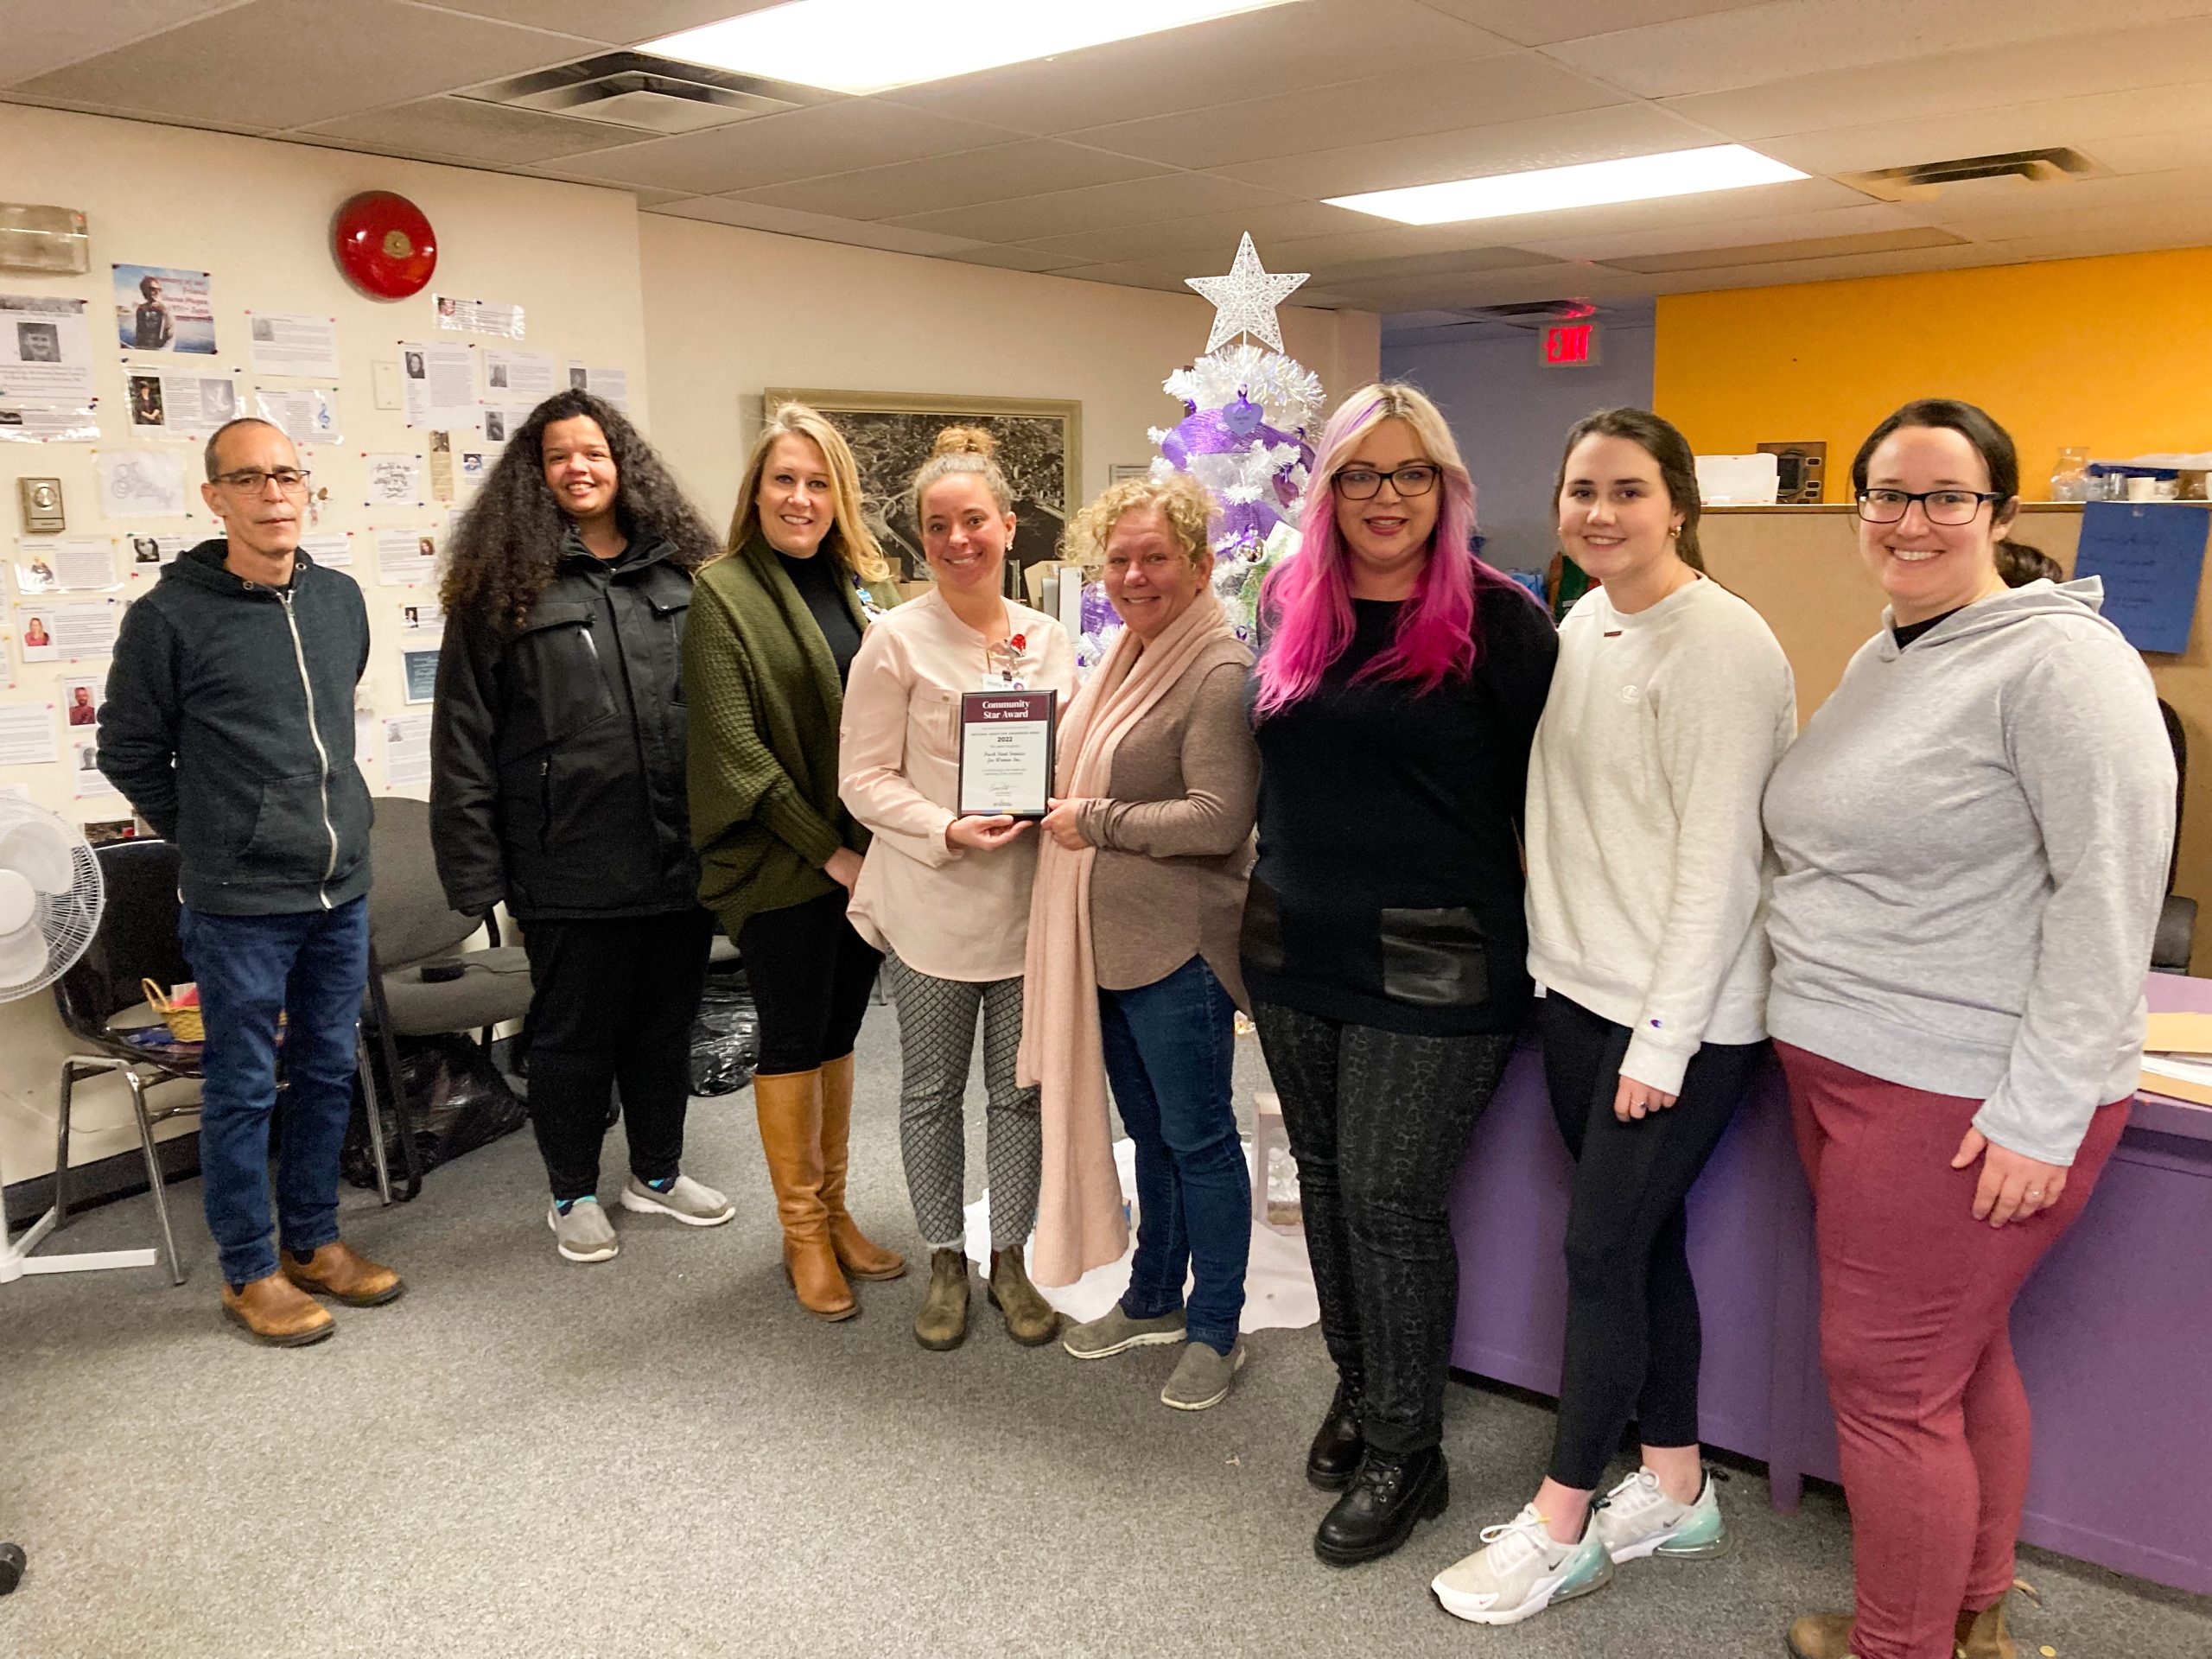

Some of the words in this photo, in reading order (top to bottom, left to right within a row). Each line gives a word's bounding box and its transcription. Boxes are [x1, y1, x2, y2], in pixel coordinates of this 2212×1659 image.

[1548, 325, 1592, 362] EXIT
[982, 699, 1030, 710] Community
[983, 710, 1001, 719] Star
[1002, 709, 1029, 719] Award
